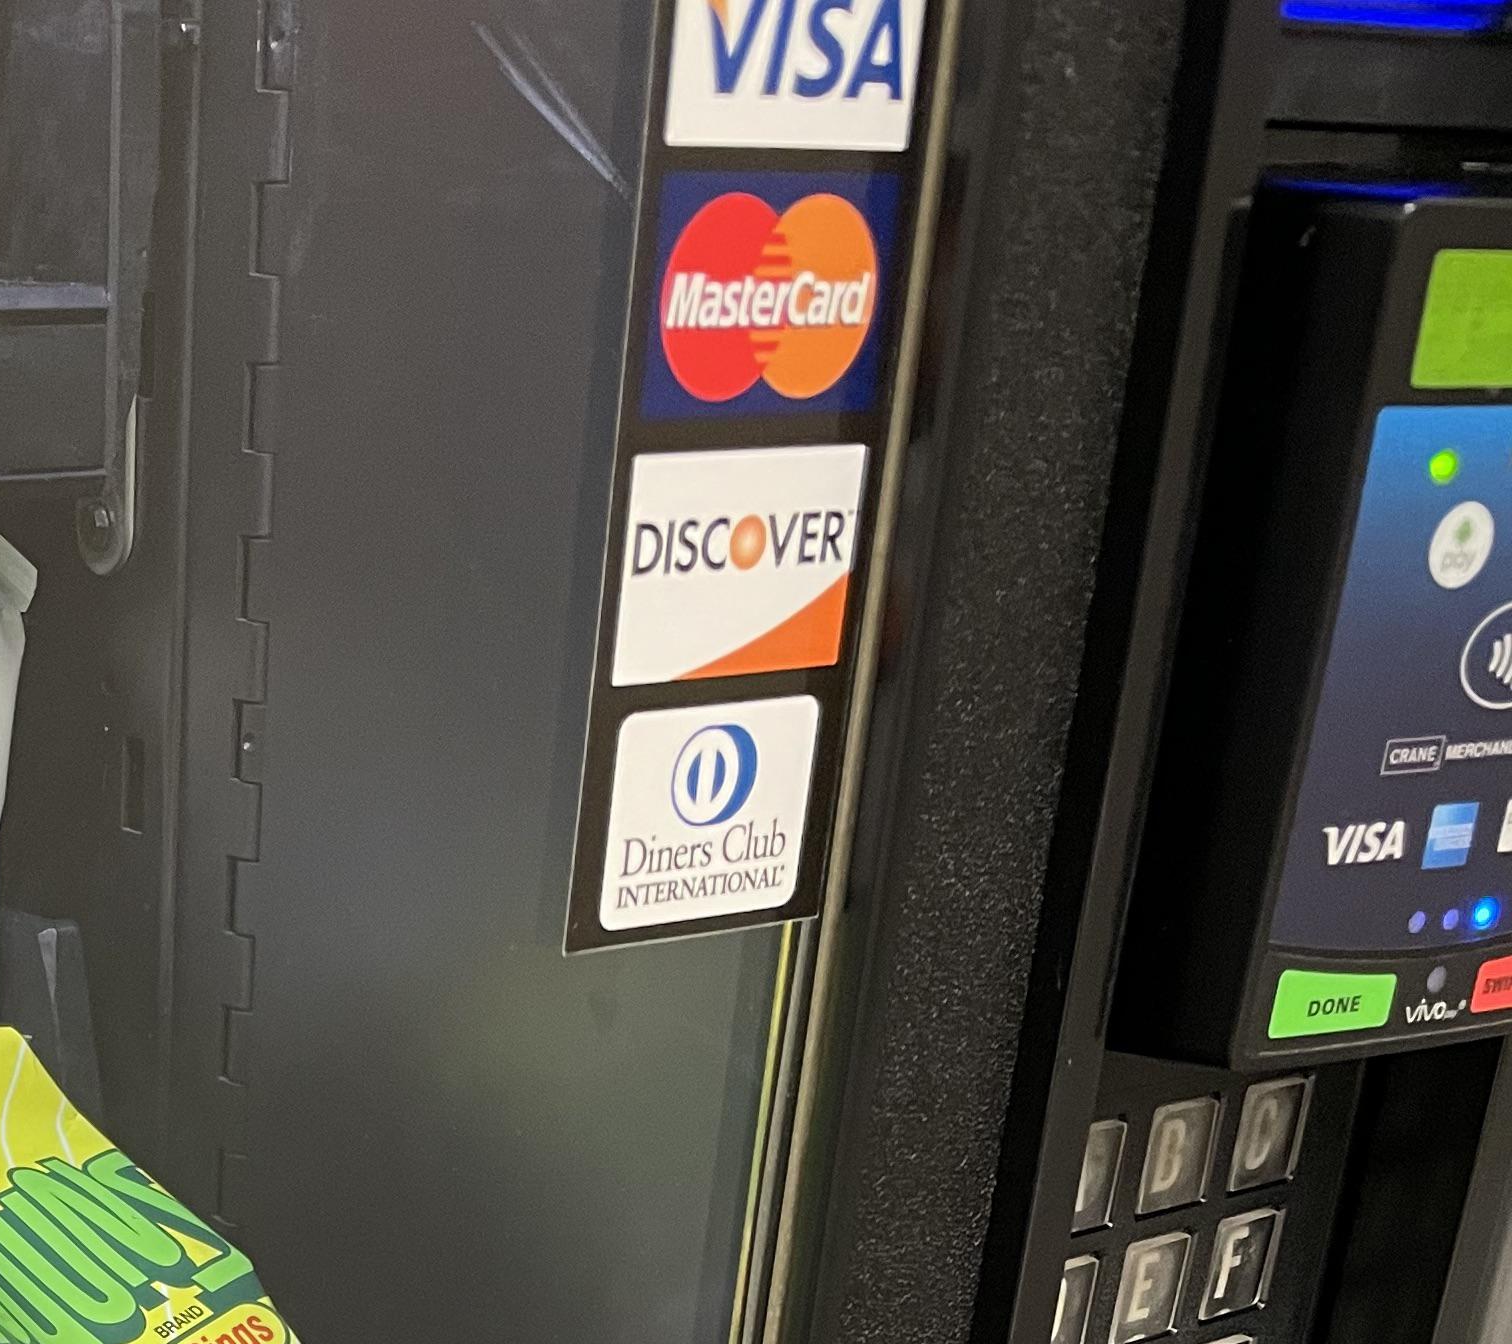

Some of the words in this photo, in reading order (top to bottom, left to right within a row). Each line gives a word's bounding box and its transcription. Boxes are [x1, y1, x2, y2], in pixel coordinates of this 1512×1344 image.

[708, 0, 904, 100] VISA
[664, 270, 872, 332] MasterCard
[631, 510, 845, 577] DISCOVER
[1389, 745, 1439, 765] CRANE
[618, 833, 713, 878] Diners
[721, 818, 787, 862] Club
[1322, 820, 1405, 866] VISA
[616, 863, 787, 909] INTERNATIONAL
[1307, 995, 1362, 1018] DONE
[1150, 1118, 1187, 1194] B
[1127, 1252, 1162, 1322] E
[1213, 1226, 1250, 1299] F
[152, 1303, 205, 1339] BRAND
